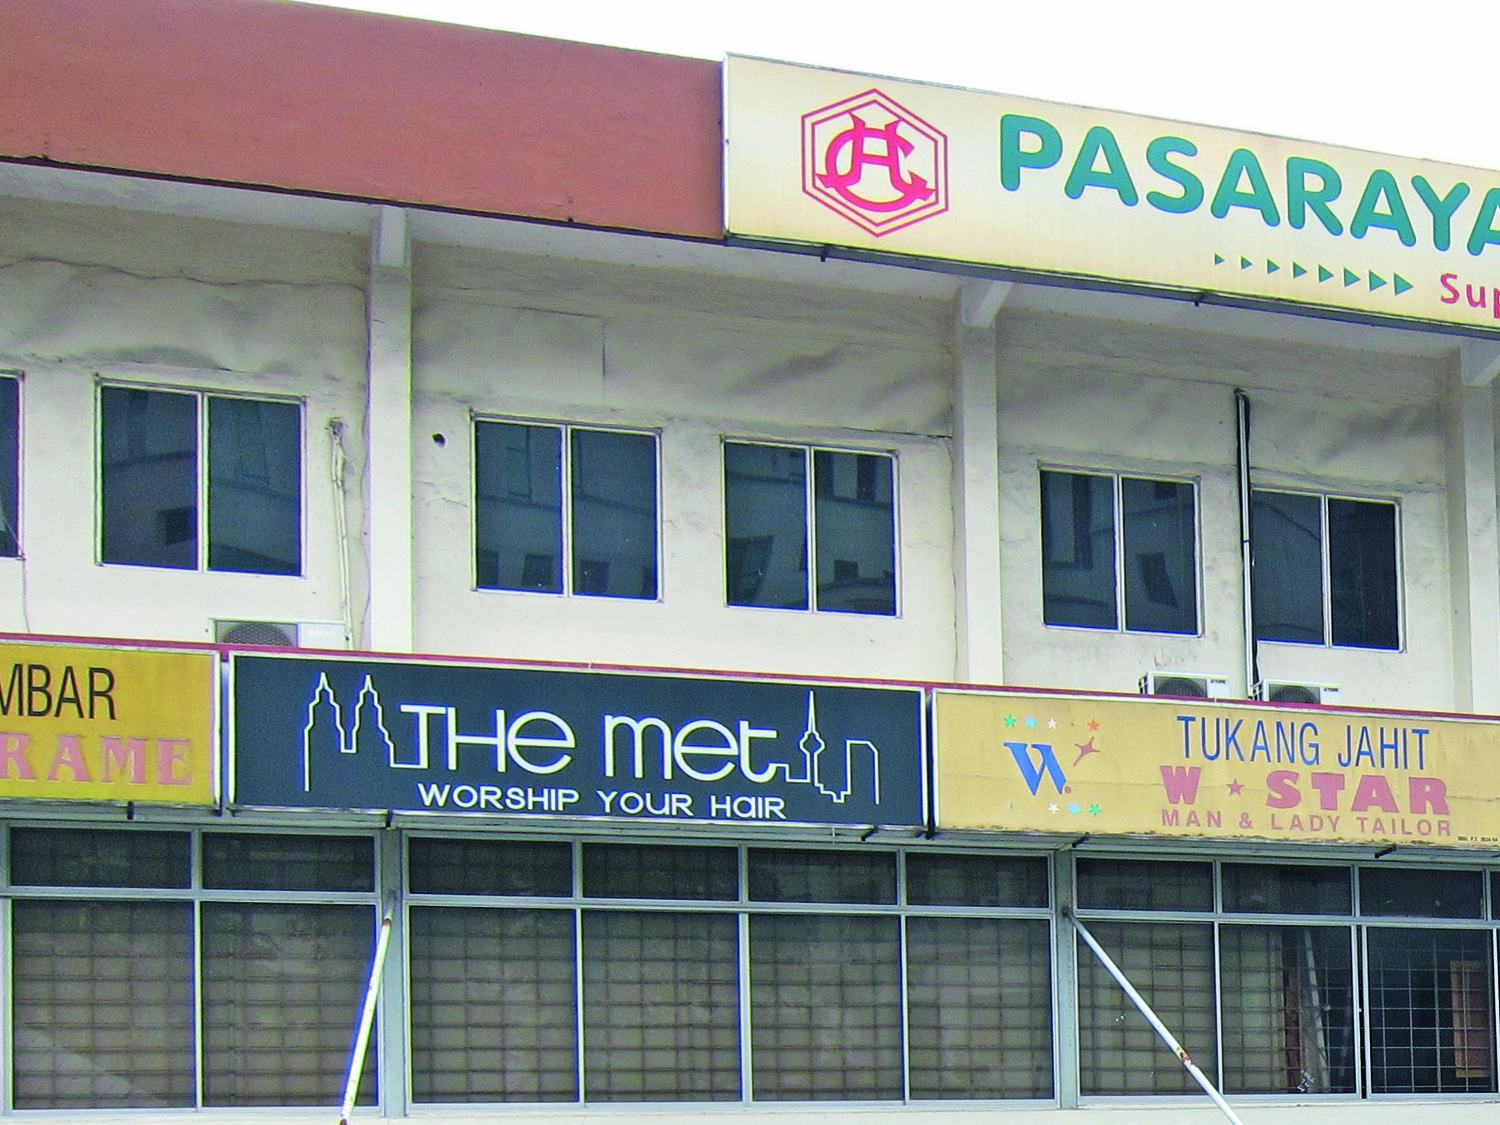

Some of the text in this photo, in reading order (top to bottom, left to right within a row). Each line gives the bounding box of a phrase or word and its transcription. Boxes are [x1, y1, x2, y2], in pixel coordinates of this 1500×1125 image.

[0, 731, 194, 786] RAME
[1177, 715, 1429, 770] TUKANG JAHIT
[418, 783, 579, 811] WORSHIP
[597, 790, 694, 816] YOUR
[1160, 765, 1450, 815] W STAR
[1161, 809, 1451, 836] MAN & LADY TAILOR
